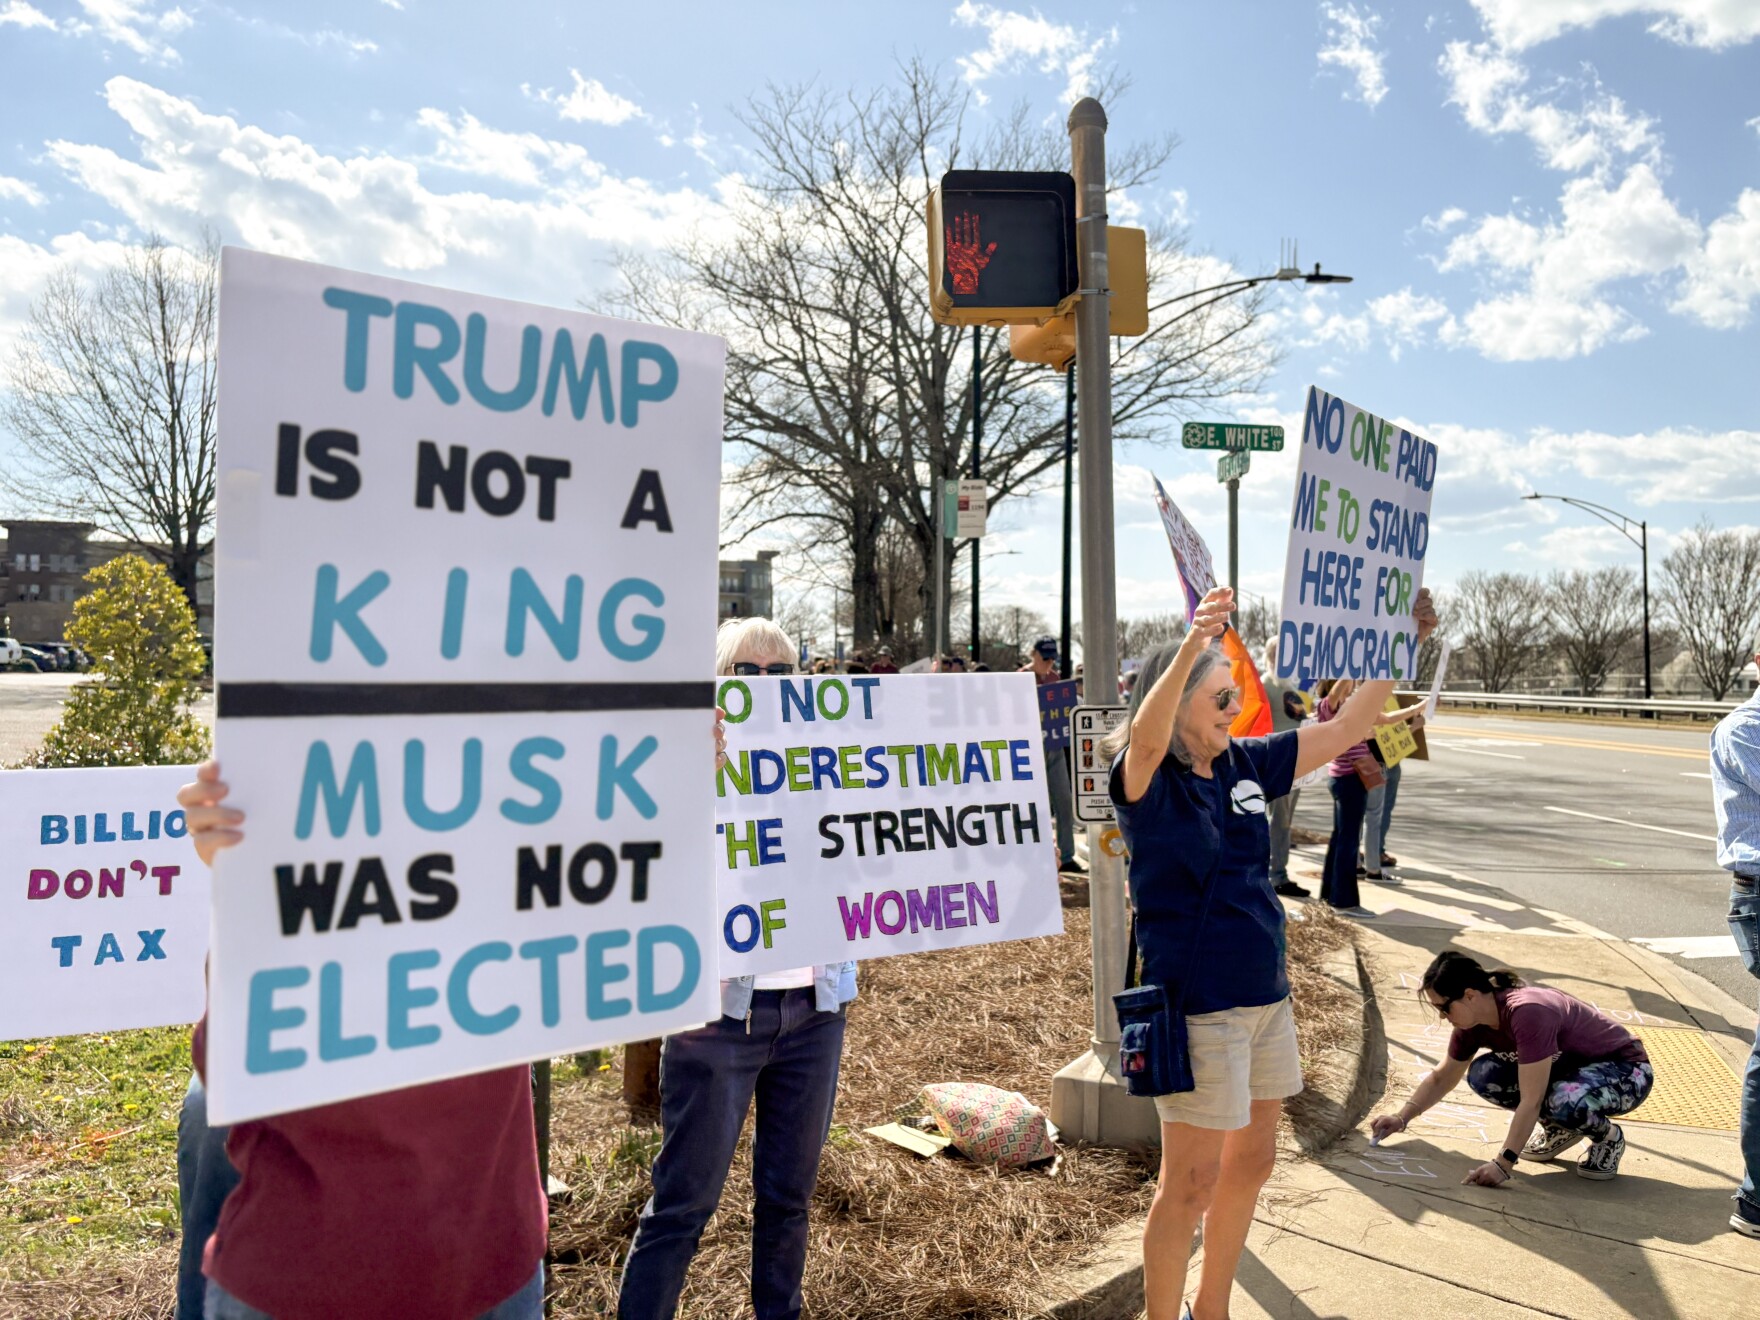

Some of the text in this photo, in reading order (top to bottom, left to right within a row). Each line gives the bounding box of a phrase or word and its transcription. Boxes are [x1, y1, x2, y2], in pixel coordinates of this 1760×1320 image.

[322, 286, 679, 428] TRUMP
[1207, 426, 1219, 446] E.
[1225, 427, 1269, 448] WHITE
[1303, 385, 1437, 492] NO ONE PAID
[275, 422, 674, 533] IS NOT A
[1293, 471, 1429, 561] ME TO STAND
[309, 563, 666, 668] KING
[1300, 548, 1412, 617] HERE FOR
[1277, 620, 1418, 680] DEMOCRACY
[717, 678, 880, 724] O NOT
[1047, 687, 1069, 701] ER
[1042, 726, 1070, 739] PLE
[294, 733, 659, 841] MUSK
[716, 740, 1033, 797] NDERESTIMATE
[40, 809, 189, 845] BILLIO
[716, 802, 1040, 870] HE STRENGTH
[27, 859, 181, 900] DON'T
[274, 840, 663, 937] WAS NOT
[51, 928, 167, 968] TAX
[723, 880, 999, 954] OF WOMEN
[245, 924, 701, 1076] ELECTED
